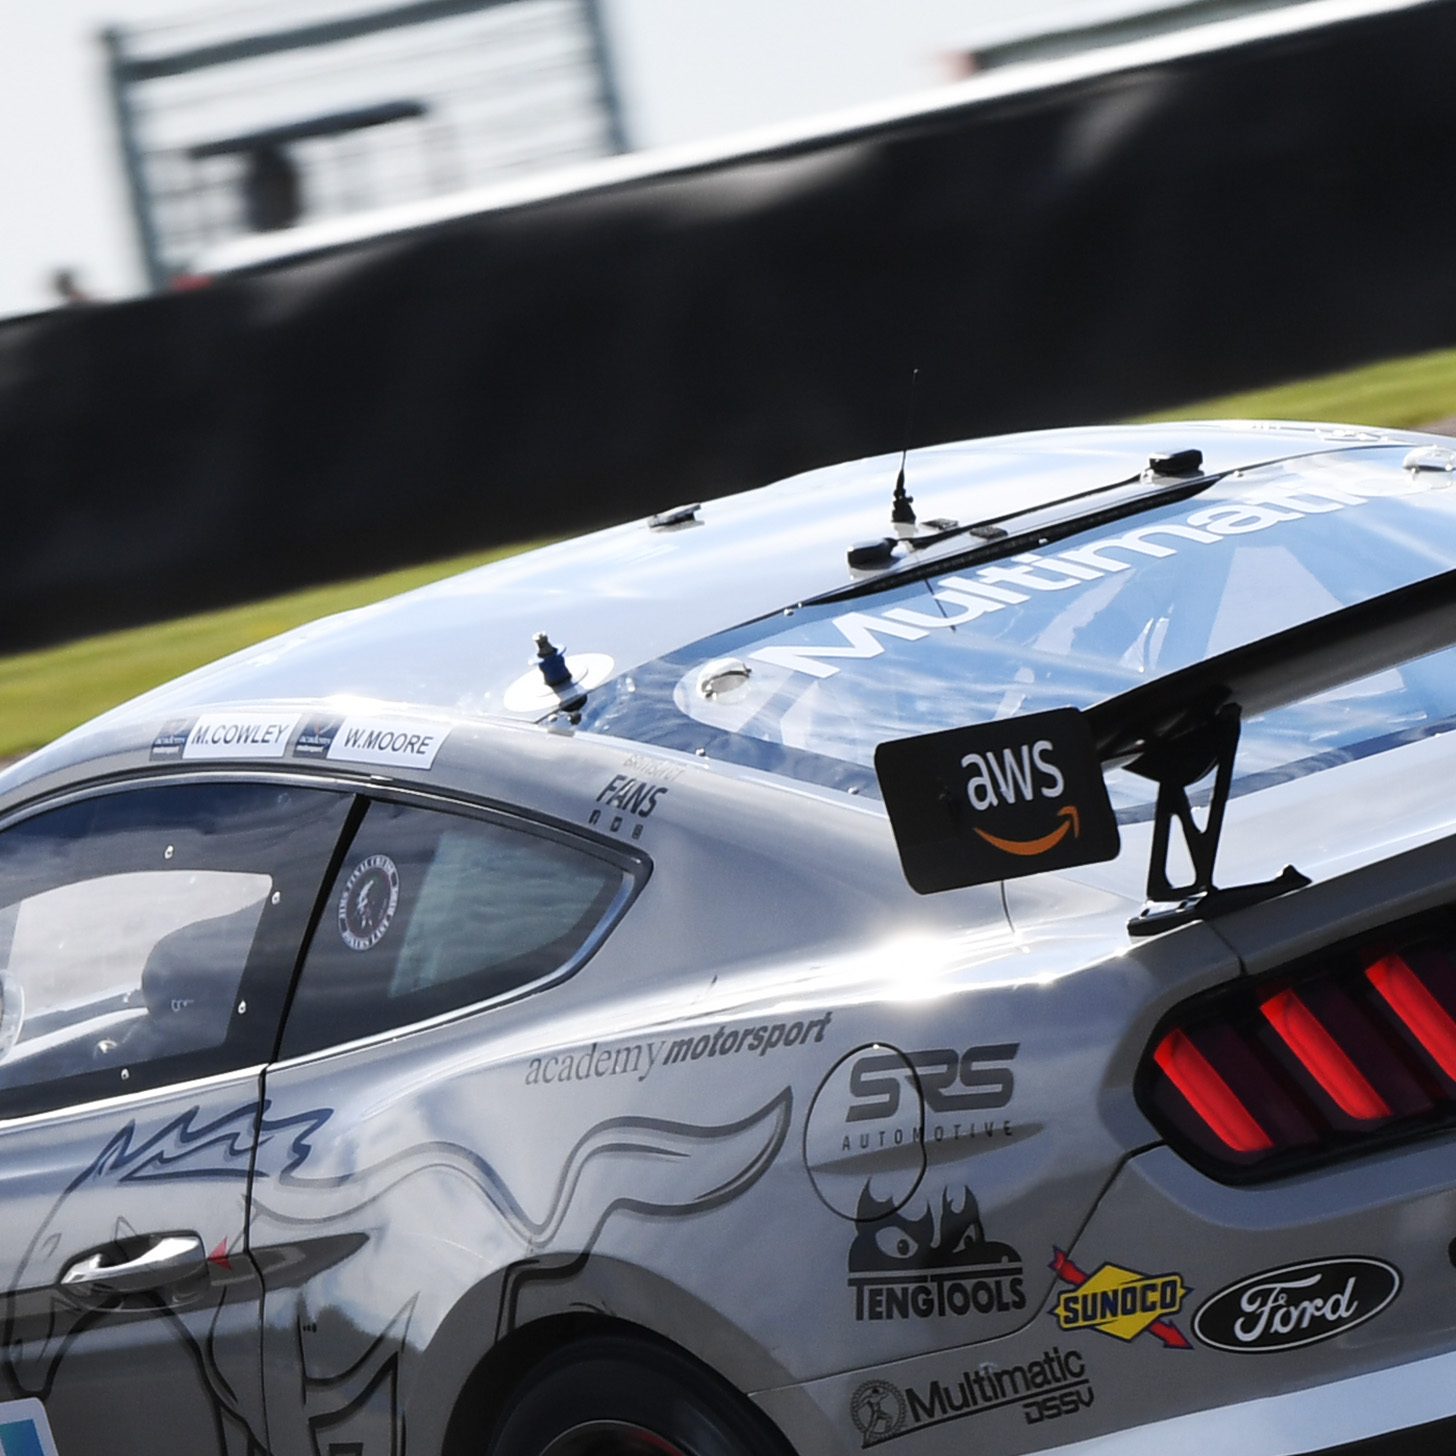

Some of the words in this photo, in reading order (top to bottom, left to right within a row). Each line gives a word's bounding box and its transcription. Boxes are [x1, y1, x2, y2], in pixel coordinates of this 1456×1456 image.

[748, 474, 1376, 679] Multimati
[191, 724, 291, 744] M.COWLEY
[343, 728, 433, 755] W.MOORE
[596, 775, 668, 818] FANS
[961, 740, 1064, 811] aws
[525, 1037, 664, 1085] academy
[663, 1012, 832, 1067] motorsport
[845, 1042, 1020, 1123] SRS
[841, 1120, 1014, 1152] AUTOMOTIVE
[1060, 1273, 1182, 1330] SUNOCO
[1233, 1274, 1360, 1343] Ford
[905, 1347, 1085, 1423] Multimatic
[1023, 1387, 1094, 1425] DSSV
